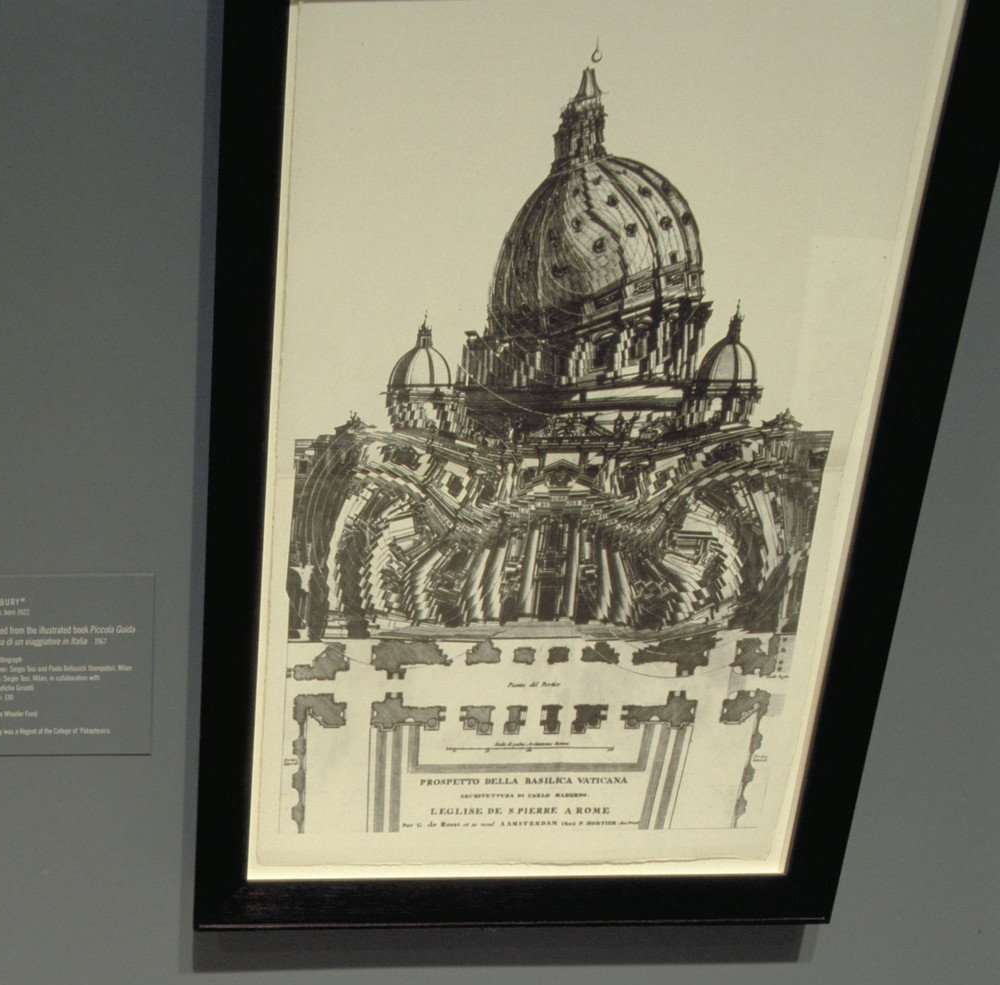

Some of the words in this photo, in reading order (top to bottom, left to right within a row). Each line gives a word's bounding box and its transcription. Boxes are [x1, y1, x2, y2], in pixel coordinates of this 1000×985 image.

[9, 626, 25, 635] from
[26, 626, 37, 635] the
[38, 626, 71, 635] illustrated
[73, 625, 89, 634] book
[90, 625, 114, 634] Piccola
[116, 625, 136, 634] Guida
[6, 638, 14, 646] di
[14, 638, 24, 646] un
[70, 637, 88, 645] Italia
[37, 665, 48, 673] and
[118, 664, 133, 672] Milan
[420, 778, 480, 786] PROSPETTO
[484, 777, 519, 786] DELLA
[577, 776, 628, 784] VATICANA
[487, 807, 503, 815] DE
[565, 807, 572, 815] A
[575, 806, 610, 815] ROME
